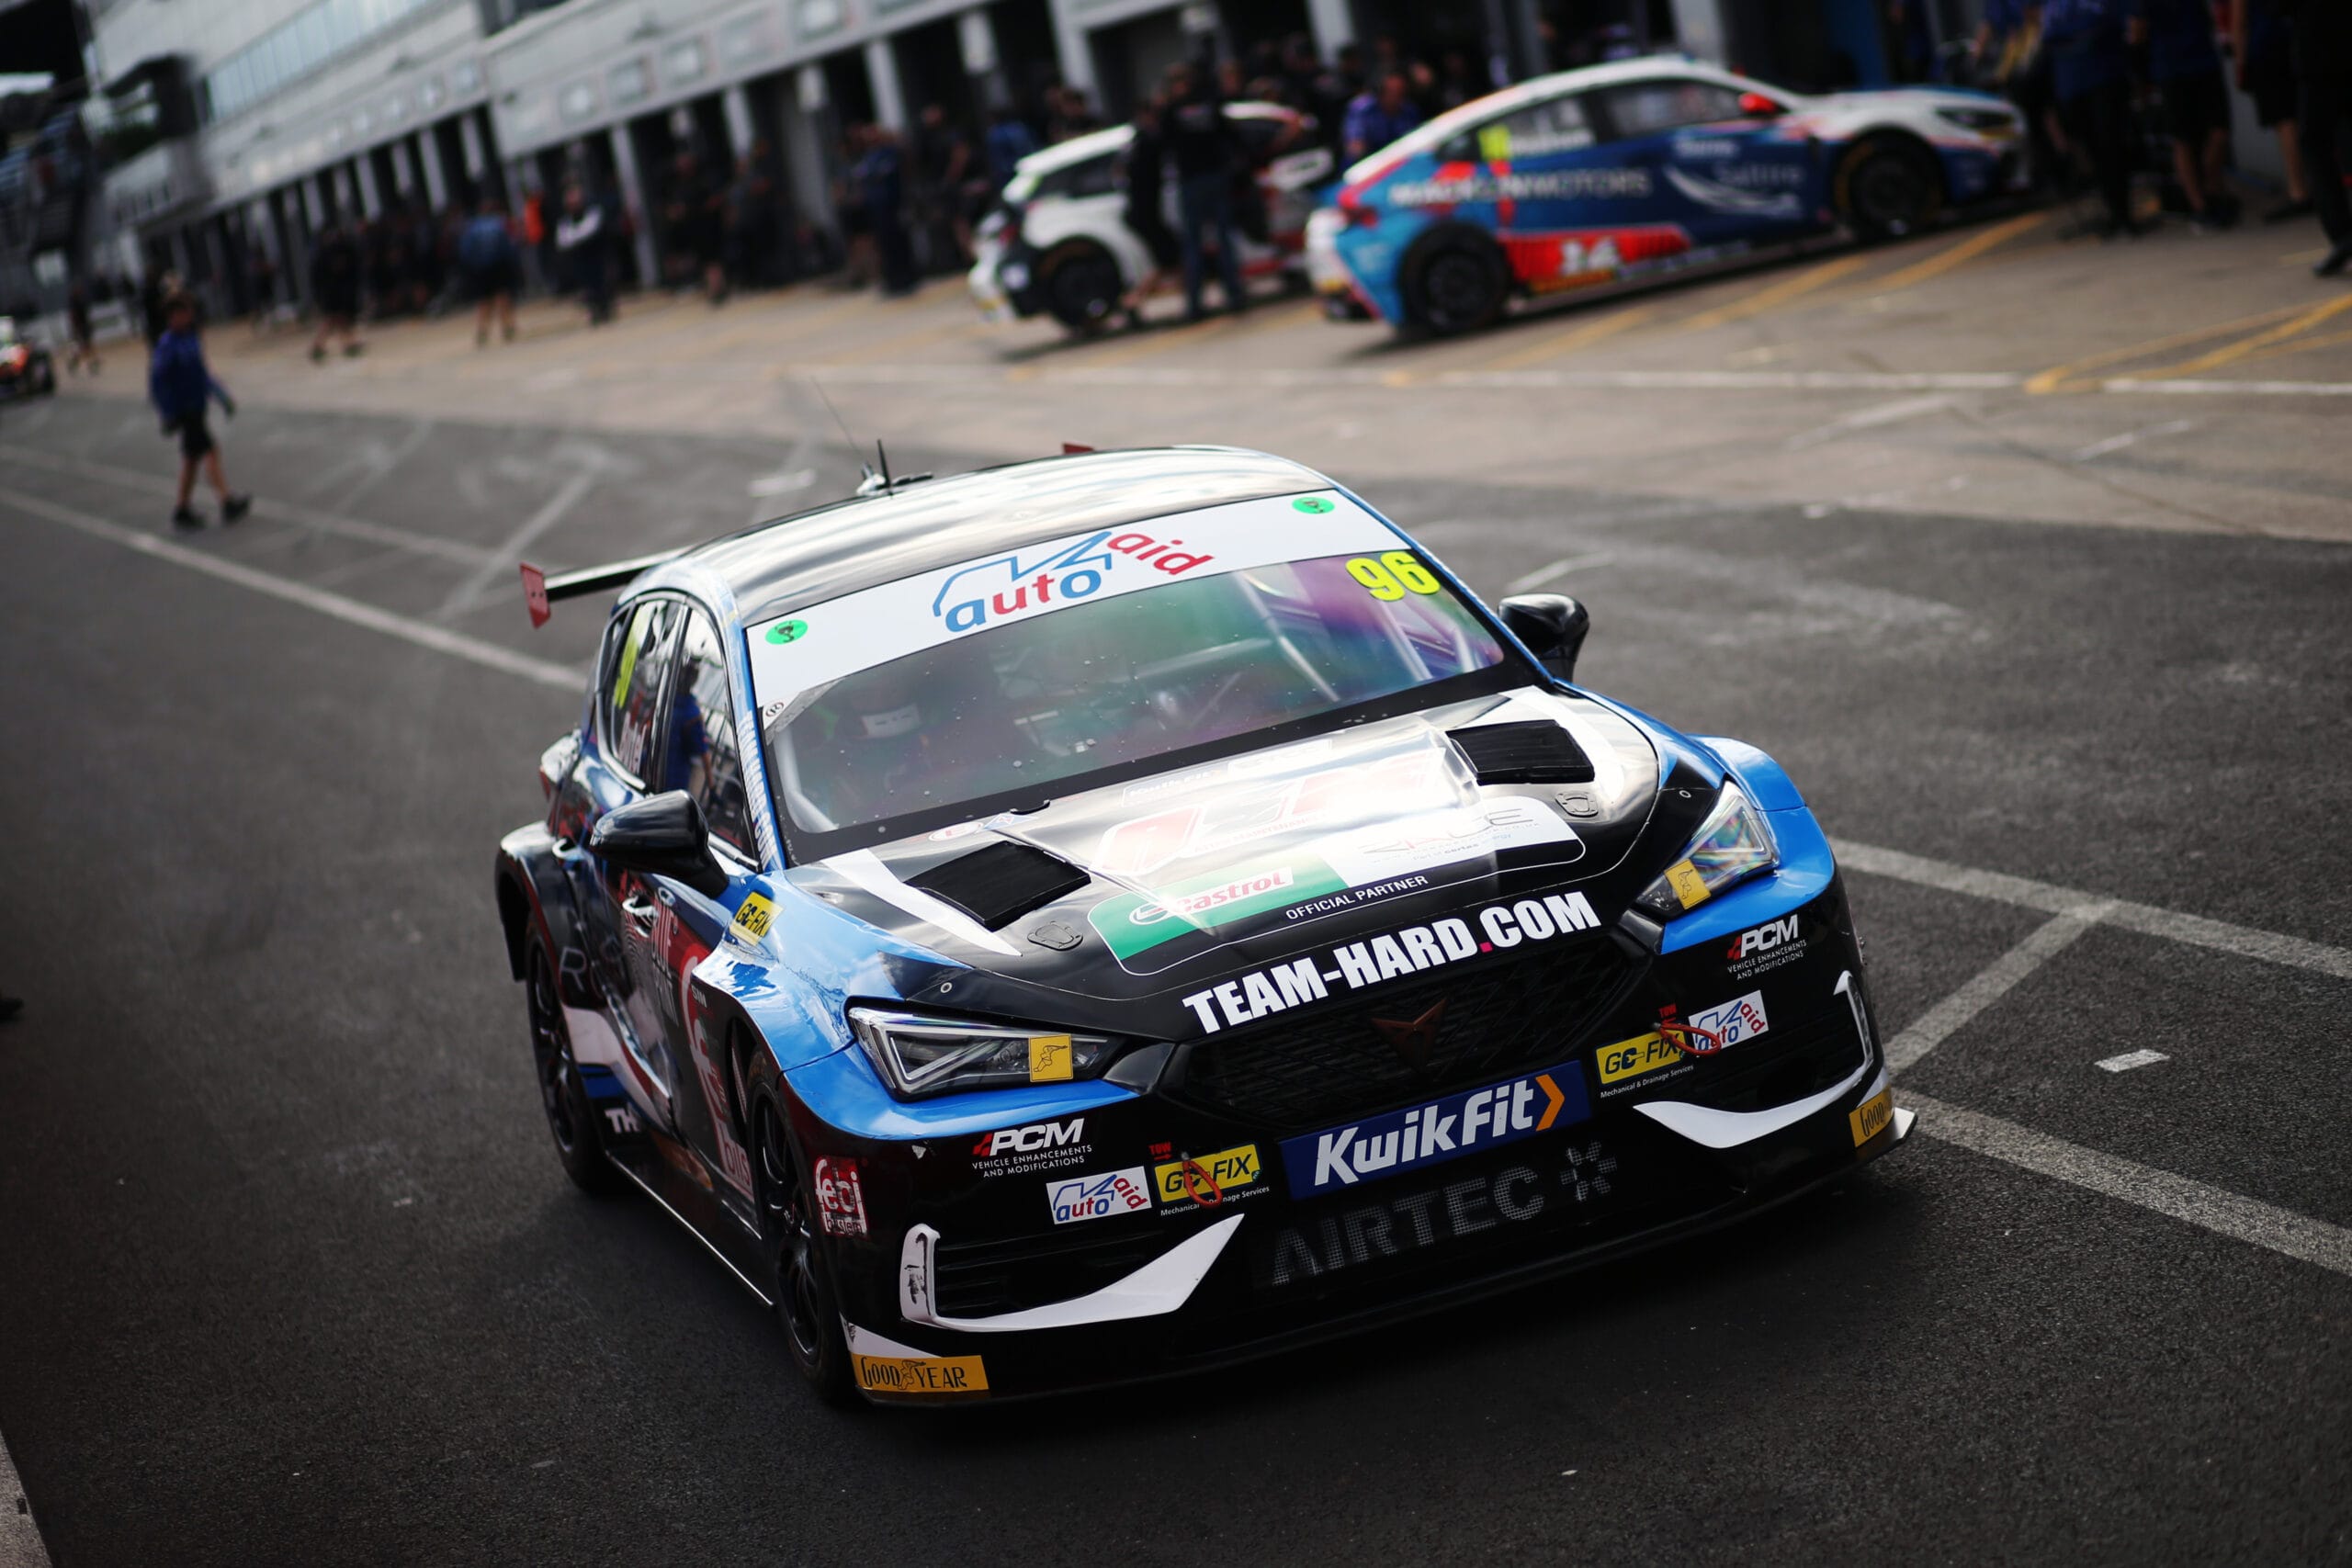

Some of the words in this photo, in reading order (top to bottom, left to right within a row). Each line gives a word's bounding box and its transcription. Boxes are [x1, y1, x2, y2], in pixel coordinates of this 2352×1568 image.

[945, 570, 1102, 632] auto
[1107, 534, 1215, 575] aid
[1345, 551, 1442, 602] 96
[1285, 894, 1355, 919] OFFICIAL
[1355, 875, 1429, 900] PARTNER
[1182, 891, 1602, 1034] TEAM-HARD.COM
[1727, 958, 1756, 973] VEHICLE
[1758, 939, 1806, 963] ENHANCEMENTS
[1736, 969, 1752, 980] AND
[1754, 950, 1804, 974] MODIFICATIONS
[1740, 1003, 1766, 1033] aid
[1600, 1083, 1635, 1099] Mechanical
[1642, 1073, 1669, 1086] Drainage
[1670, 1065, 1694, 1077] Services
[972, 1157, 1010, 1169] VEHICLE
[1013, 1145, 1092, 1165] ENHANCEMENTS
[983, 1169, 1003, 1178] AND
[1007, 1156, 1085, 1175] MODIFICATIONS
[1056, 1197, 1110, 1222] auto
[1114, 1178, 1148, 1210] aid
[1242, 1186, 1270, 1198] Services
[1272, 1166, 1545, 1287] AIRTEC
